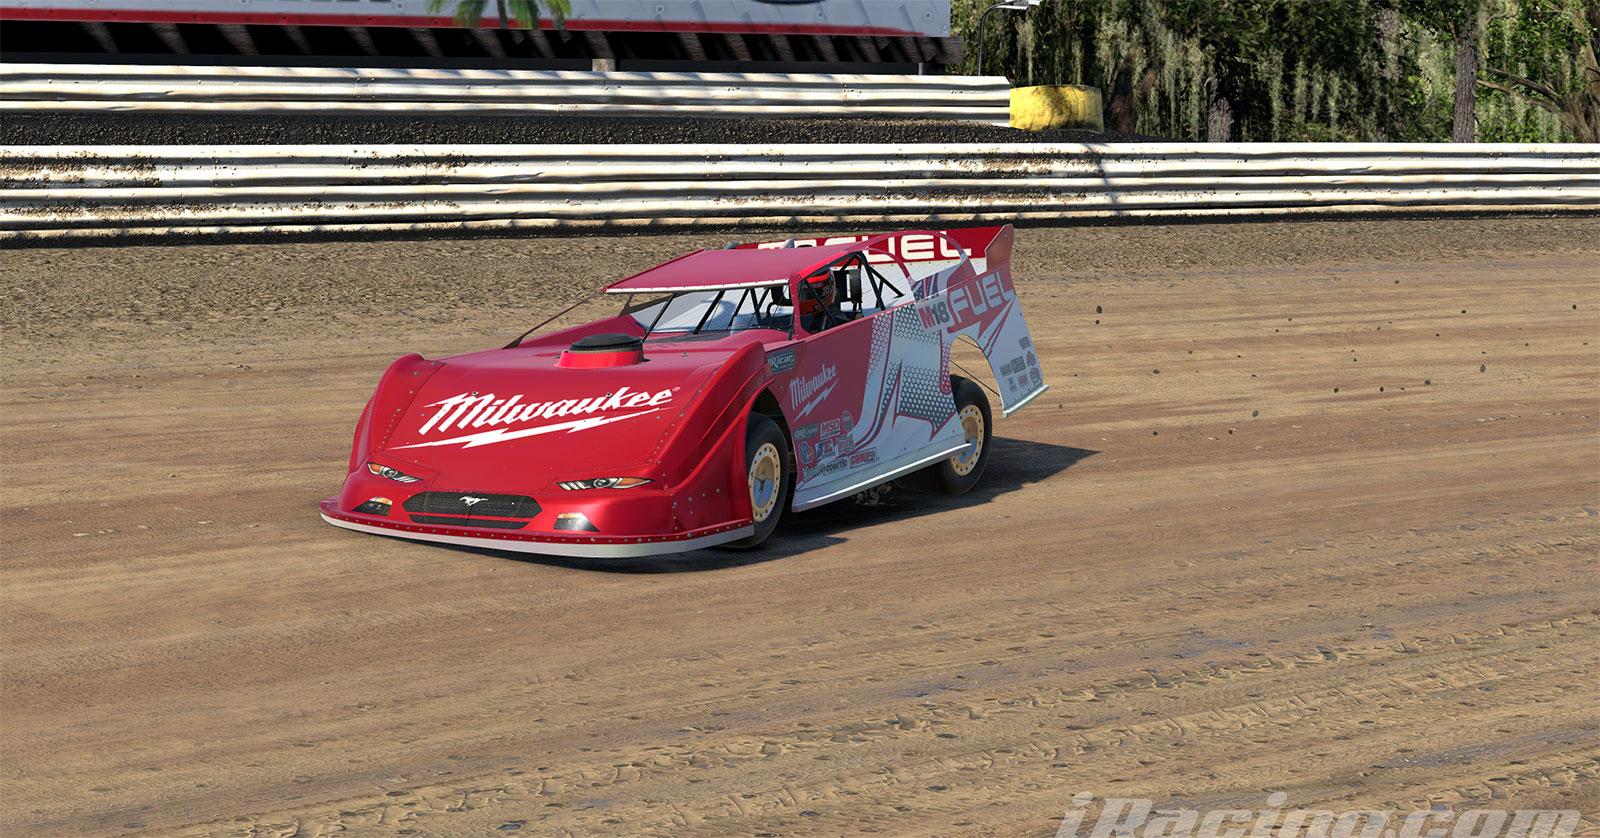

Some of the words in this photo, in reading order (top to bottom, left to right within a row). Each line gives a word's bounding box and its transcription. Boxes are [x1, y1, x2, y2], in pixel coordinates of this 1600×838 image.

[917, 301, 951, 329] M18
[949, 271, 1015, 323] FUEL
[418, 386, 673, 436] Milwaukee
[789, 363, 837, 411] Milwaukee
